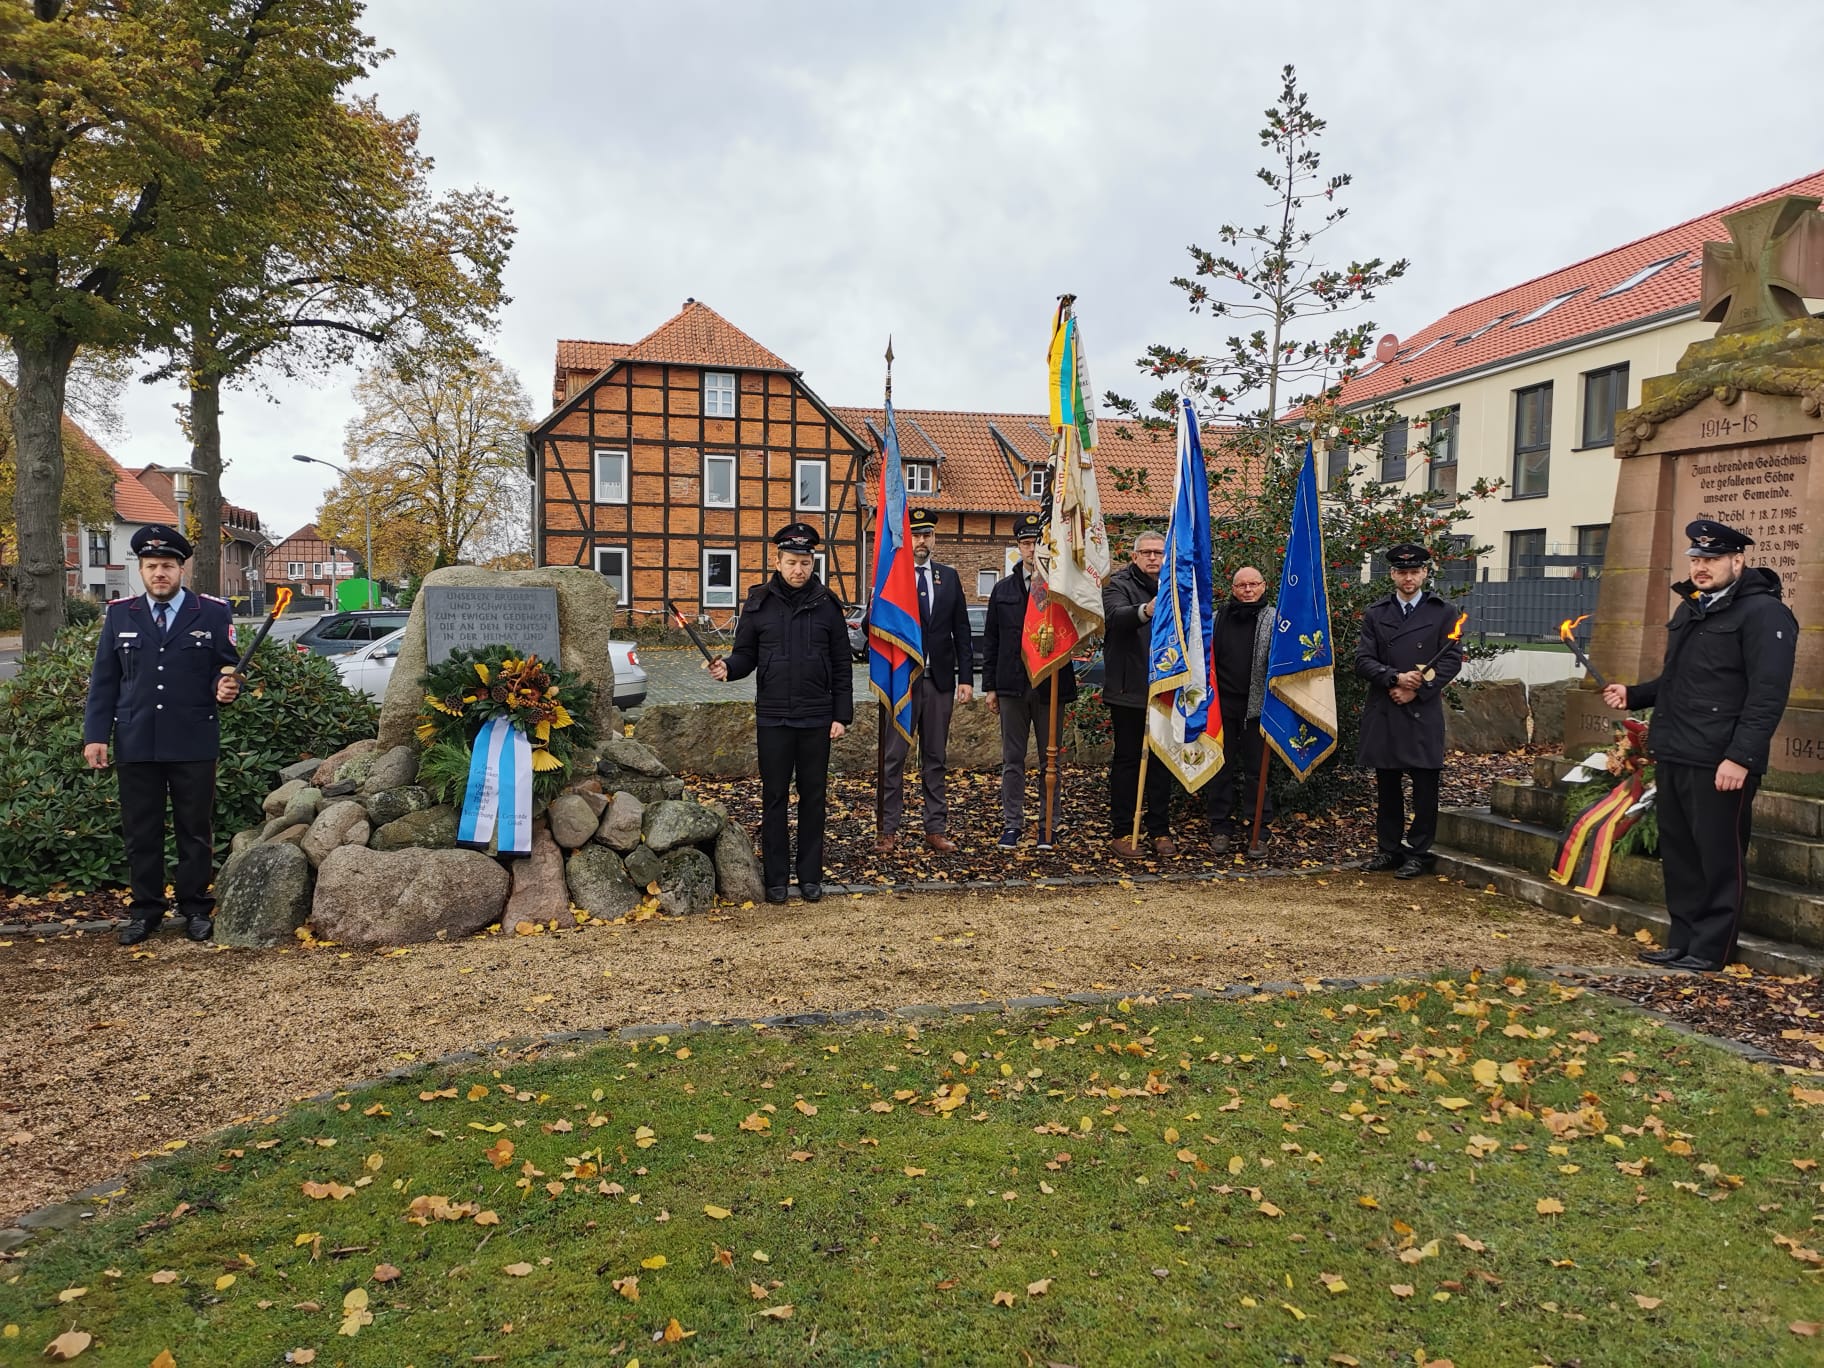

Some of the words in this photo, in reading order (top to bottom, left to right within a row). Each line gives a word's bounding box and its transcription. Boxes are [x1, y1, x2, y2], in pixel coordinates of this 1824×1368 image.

[1701, 414, 1759, 438] 1914-18
[1691, 464, 1712, 477] Zum
[1713, 459, 1754, 474] ehrenden
[1755, 453, 1808, 470] Gedächtnis
[1700, 479, 1715, 490] der
[1716, 474, 1762, 491] gefallenen
[1764, 471, 1795, 484] Söhne
[1703, 492, 1739, 504] unserer
[1780, 507, 1798, 519] 1915
[1782, 571, 1798, 582] 1917
[447, 592, 489, 600] UNSEREN
[495, 591, 537, 600] BRÜDERN
[450, 602, 471, 610] UND
[476, 602, 536, 611] SCHWESTERN
[435, 612, 456, 620] ZUM
[462, 612, 498, 621] EWIGEN
[503, 612, 552, 621] GEDENKEN
[440, 622, 455, 631] DIE
[460, 622, 475, 631] AN
[480, 622, 499, 631] DEN
[504, 622, 548, 631] FRONTEN
[443, 632, 454, 641] IN
[460, 632, 478, 641] DER
[483, 632, 519, 641] HEIMAT
[523, 632, 545, 641] UND
[1580, 713, 1609, 733] 1939
[1785, 736, 1824, 760] 1945
